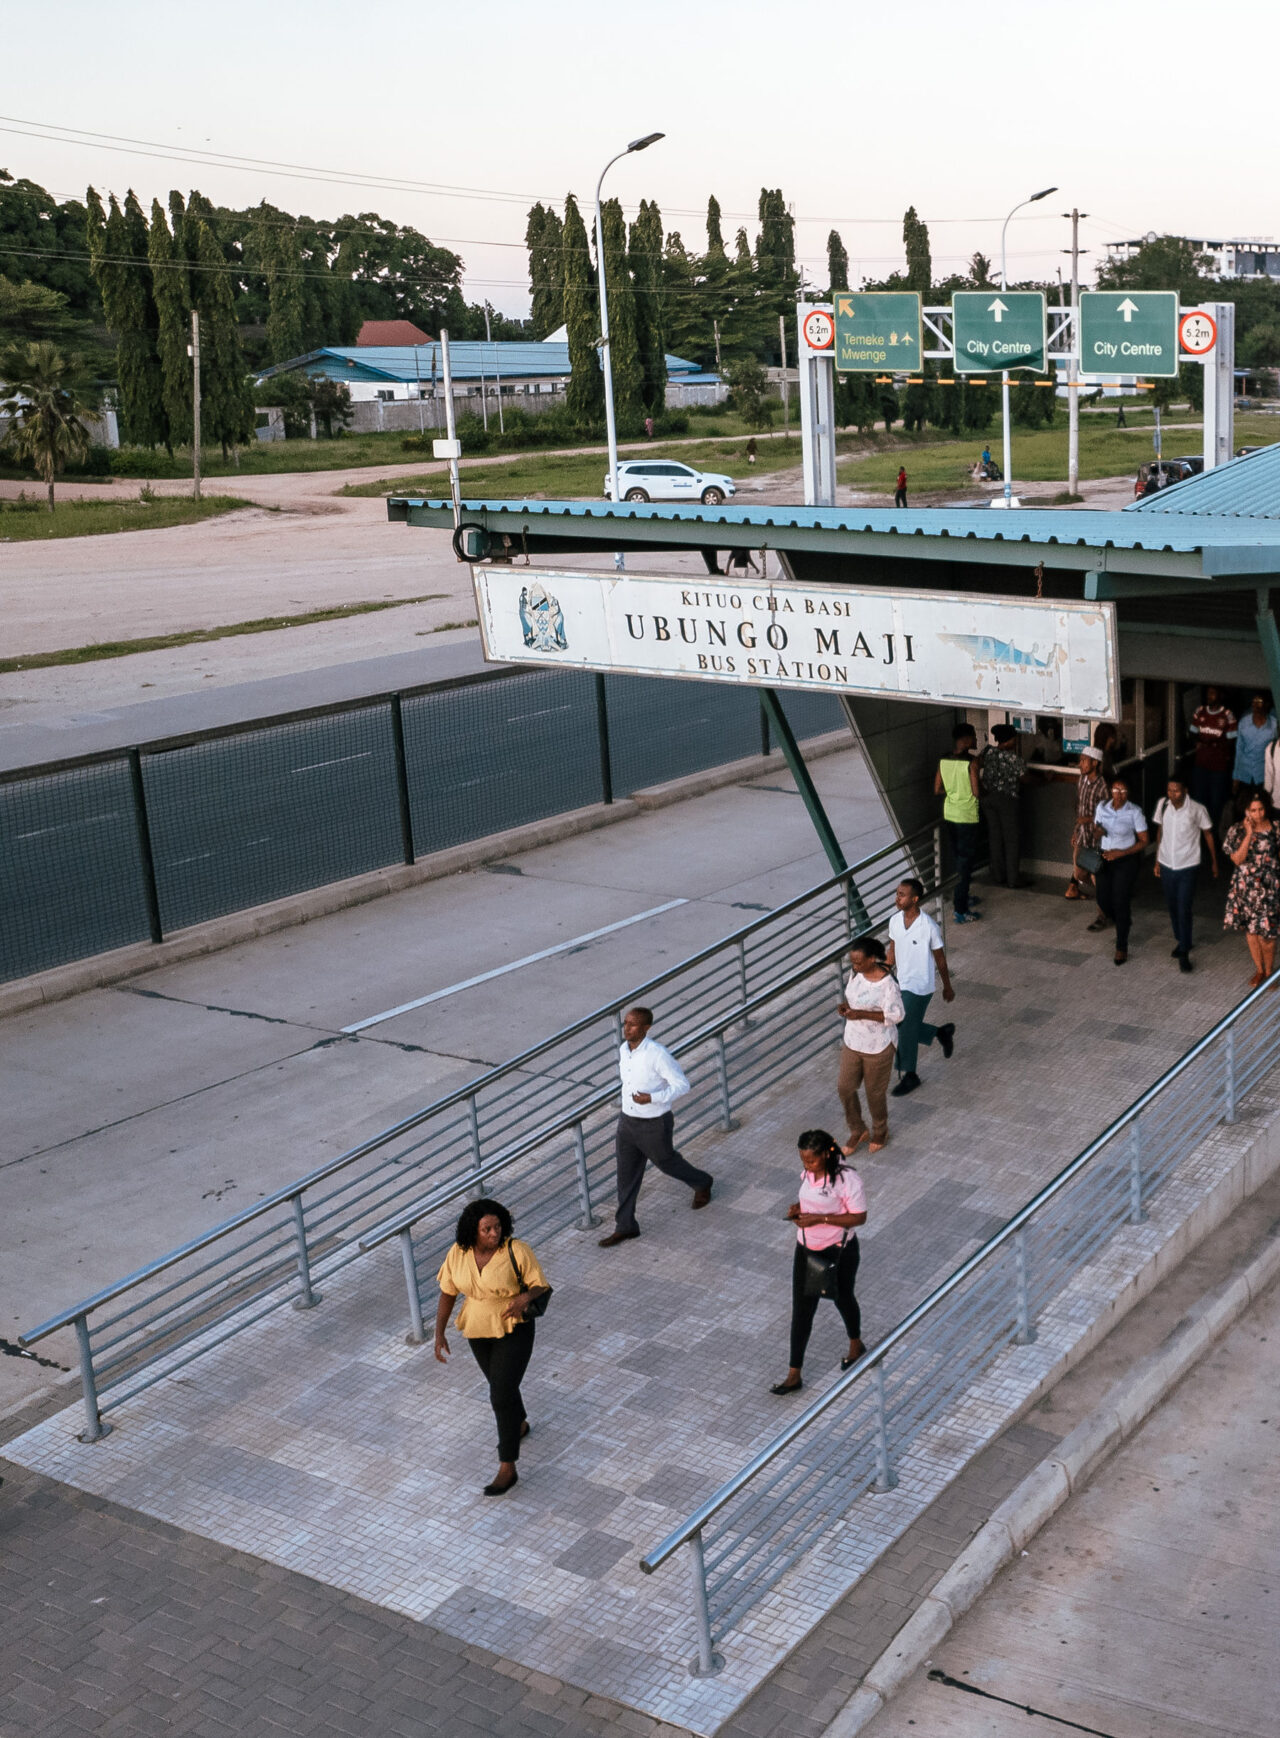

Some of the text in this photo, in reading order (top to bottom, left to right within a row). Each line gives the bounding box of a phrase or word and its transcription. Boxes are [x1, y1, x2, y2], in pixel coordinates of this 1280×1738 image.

[808, 325, 829, 335] 5.2m
[1186, 328, 1210, 338] 5.2m
[843, 333, 885, 346] Temeke
[966, 340, 1032, 356] City Centre
[841, 347, 887, 364] Mwenge
[1093, 341, 1162, 358] City Centre
[681, 590, 852, 617] KITUO CHA BASI
[625, 614, 917, 665] UBUNGO MAJI
[697, 653, 849, 683] BUS STATION
